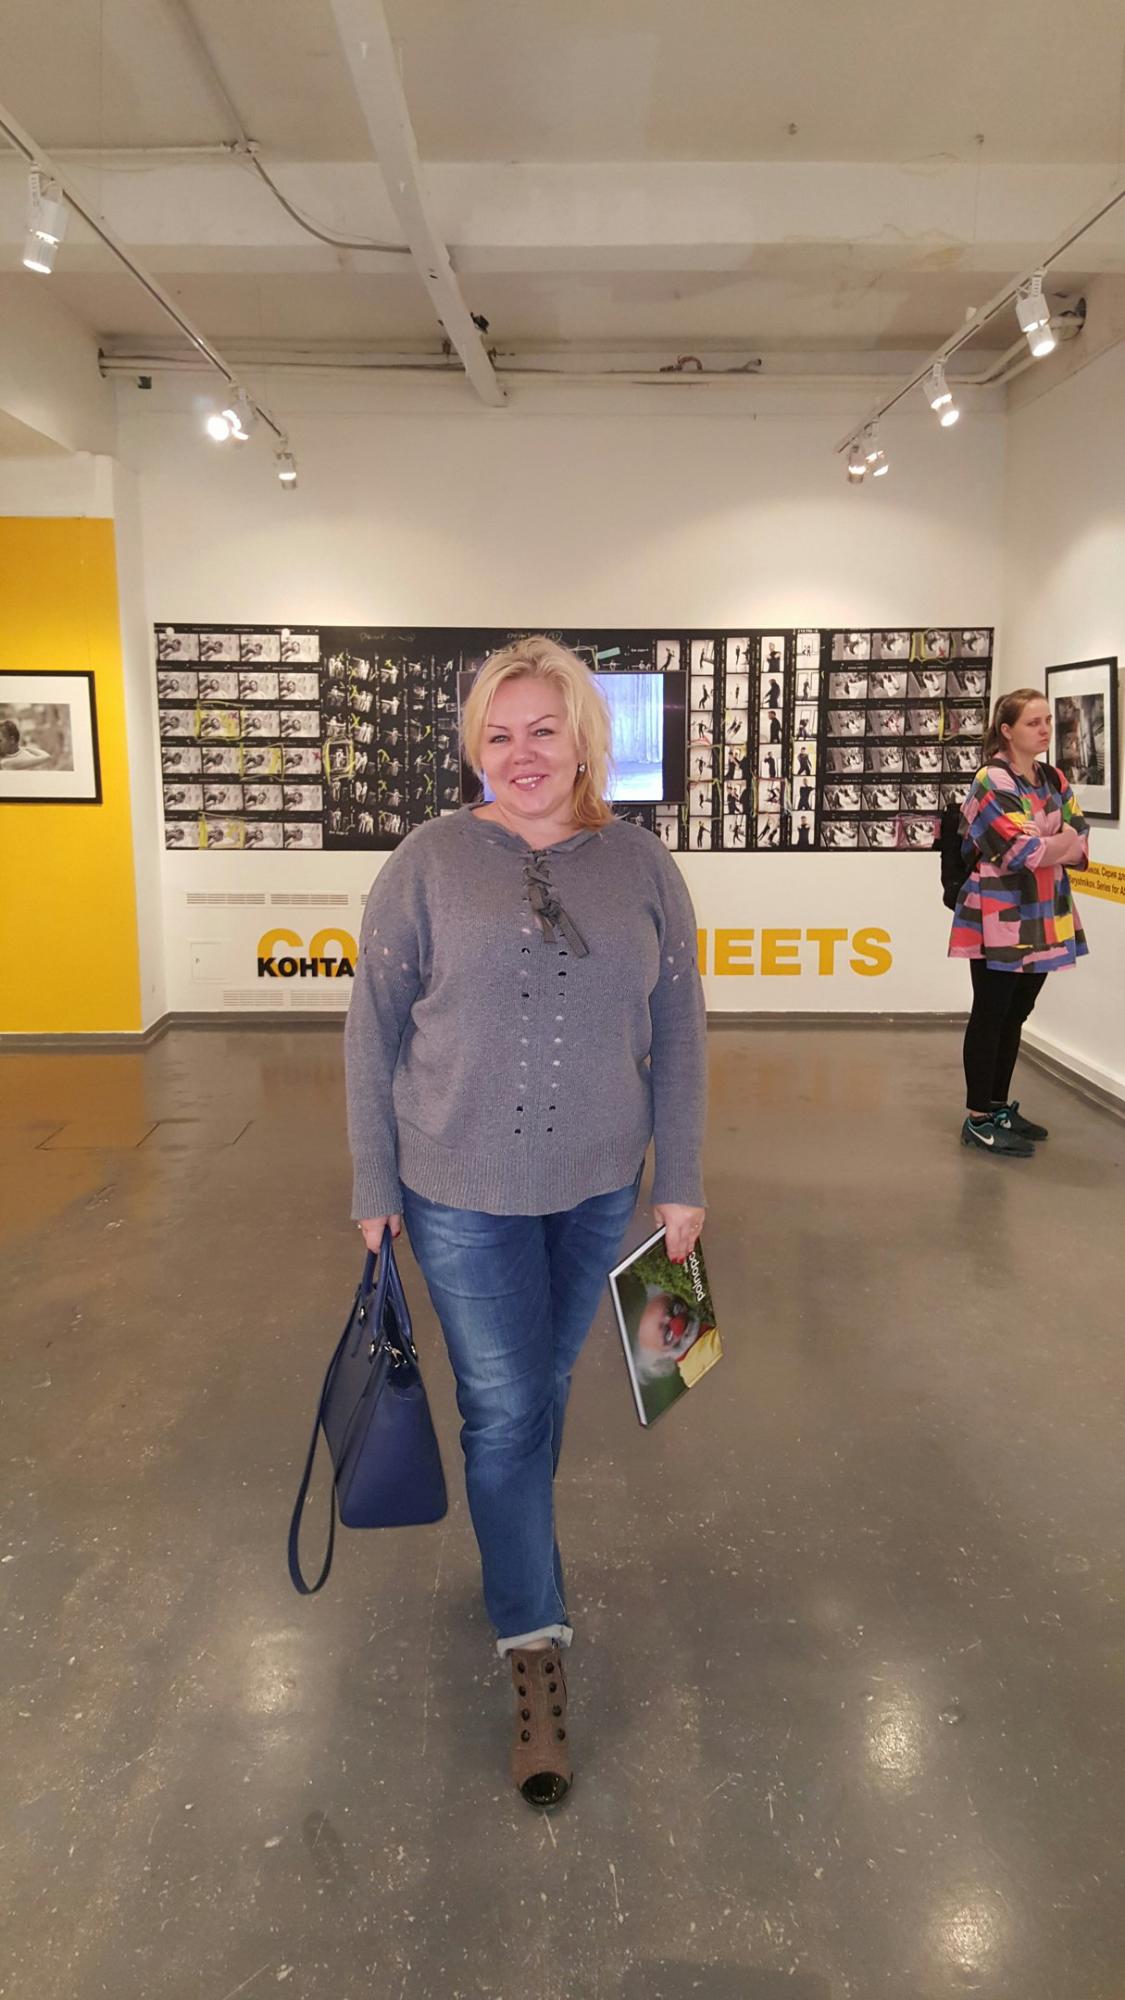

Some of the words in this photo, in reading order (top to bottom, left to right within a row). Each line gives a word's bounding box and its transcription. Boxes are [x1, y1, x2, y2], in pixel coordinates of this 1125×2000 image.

[257, 928, 358, 977] CO
[697, 927, 893, 976] EETS
[257, 957, 358, 977] КОНТА
